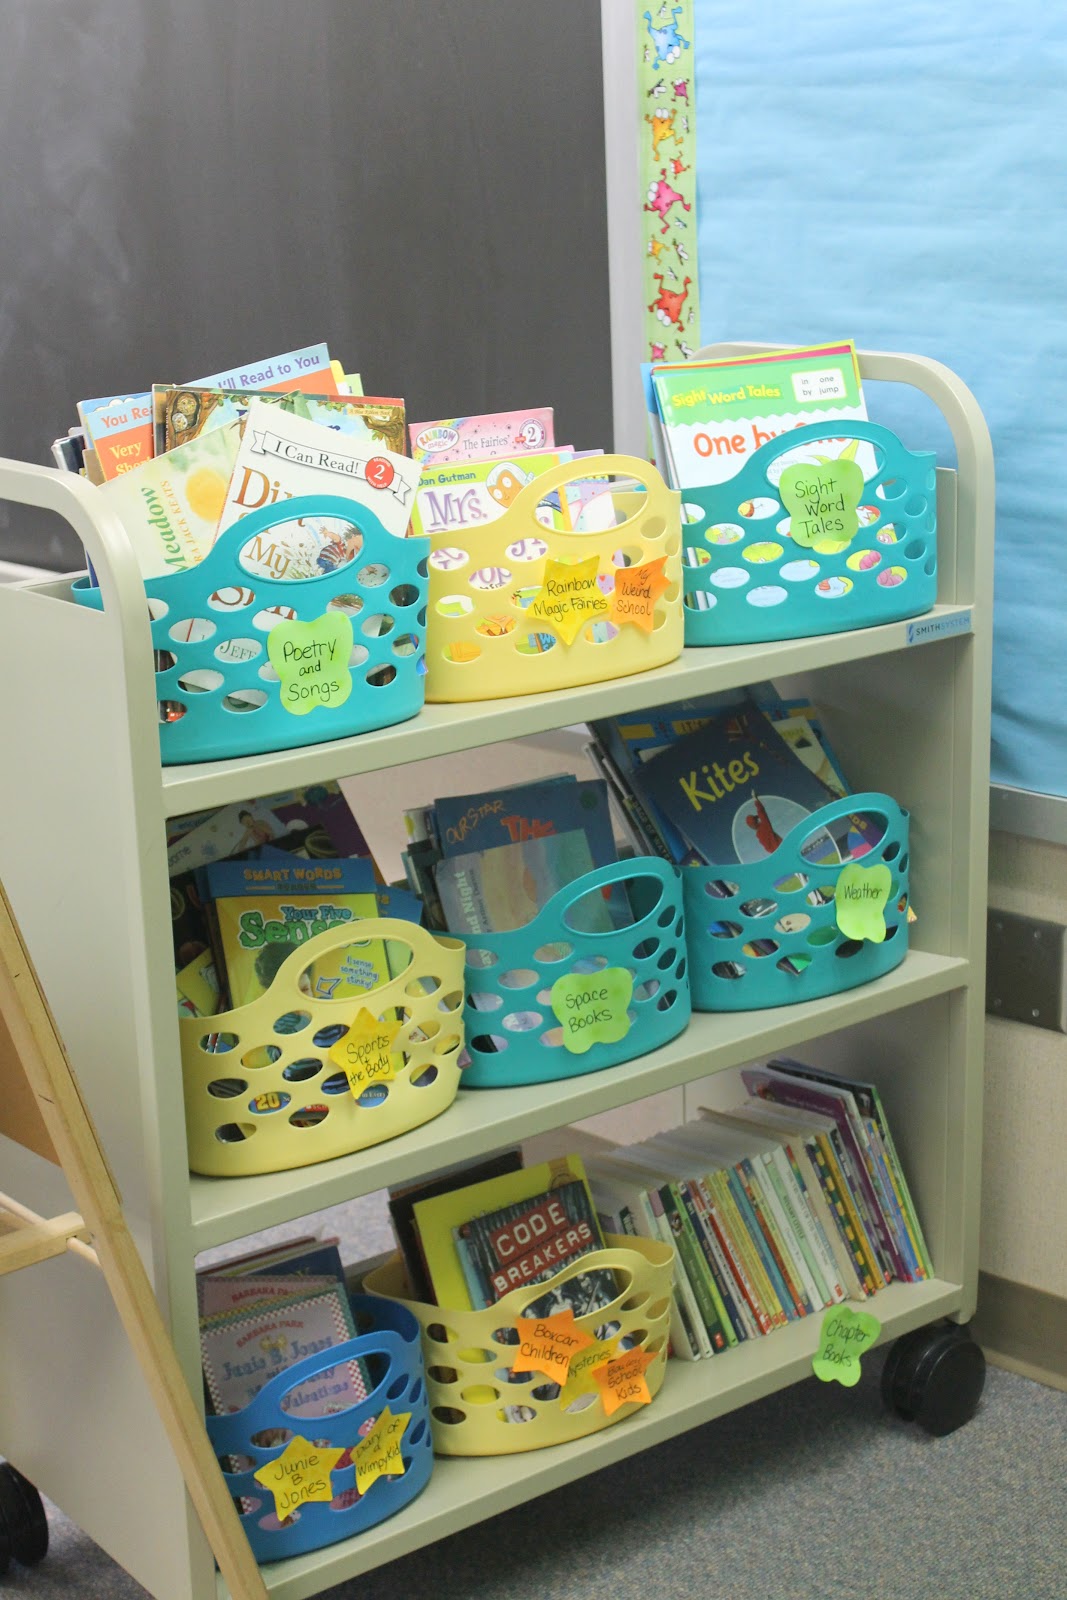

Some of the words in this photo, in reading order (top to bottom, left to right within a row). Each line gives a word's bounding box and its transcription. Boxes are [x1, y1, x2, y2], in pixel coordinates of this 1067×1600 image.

[240, 366, 275, 387] Read
[277, 364, 292, 375] to
[294, 355, 320, 369] You
[672, 390, 707, 407] Sight
[707, 387, 747, 404] Word
[746, 385, 781, 397] Tales
[819, 386, 839, 395] jump
[101, 414, 128, 428] You
[131, 406, 153, 420] Re
[419, 428, 456, 446] RAINBOW
[463, 439, 479, 450] The
[528, 427, 537, 442] 2
[693, 433, 746, 457] One
[109, 442, 142, 459] Very
[275, 440, 282, 453] I
[285, 445, 313, 464] Can
[318, 453, 359, 474] Read!
[373, 464, 385, 480] 2
[418, 477, 435, 487] Dan
[438, 472, 477, 484] Gutman
[161, 480, 182, 514] KEATS
[795, 477, 837, 504] Sight
[424, 488, 488, 527] Mrs.
[805, 493, 845, 515] Word
[141, 487, 189, 573] Meadow
[178, 518, 197, 544] JACK
[799, 517, 844, 539] Tales
[244, 535, 291, 579] My
[547, 577, 596, 596] Rainbow
[636, 569, 652, 585] My
[622, 583, 651, 599] Weird
[534, 600, 569, 622] Magic
[571, 597, 607, 611] Fairies
[617, 600, 651, 616] School
[283, 639, 337, 663] Poetry
[299, 659, 321, 677] and
[288, 681, 340, 702] Songs
[680, 752, 759, 811] Kites
[244, 868, 289, 881] SMART
[294, 867, 342, 881] WORDS
[844, 884, 883, 900] Weather
[280, 905, 319, 920] Your
[318, 905, 353, 920] Five
[340, 966, 378, 982] something
[565, 987, 608, 1009] Space
[568, 1007, 612, 1033] Books
[347, 1035, 390, 1065] Sports
[350, 1071, 364, 1086] the
[366, 1053, 390, 1077] Body
[256, 1092, 281, 1111] 20
[496, 1202, 566, 1257] CODE
[494, 1223, 591, 1293] BREAKERS
[534, 1324, 579, 1346] Boxcar
[826, 1320, 870, 1346] Chapter
[222, 1356, 266, 1381] Junie
[290, 1336, 333, 1360] Jones
[521, 1343, 569, 1368] Children
[823, 1346, 852, 1367] Books
[608, 1367, 642, 1388] School
[615, 1382, 641, 1400] Kids
[356, 1432, 381, 1458] Diary
[388, 1419, 400, 1434] of
[274, 1455, 319, 1480] Junie
[291, 1473, 303, 1486] B
[281, 1479, 327, 1509] Jones
